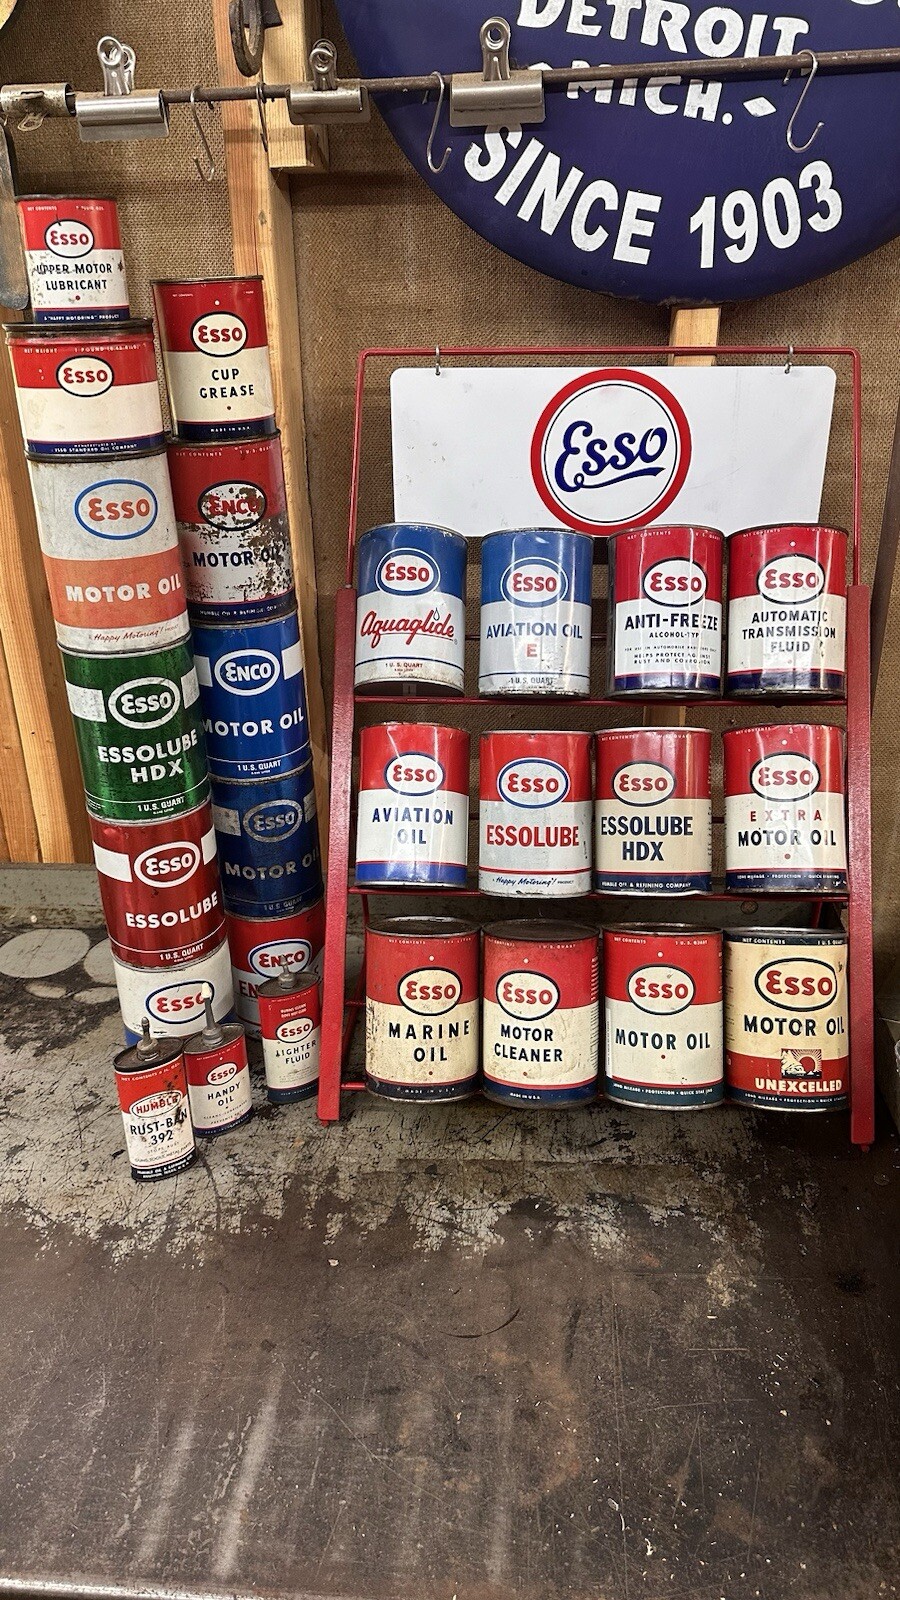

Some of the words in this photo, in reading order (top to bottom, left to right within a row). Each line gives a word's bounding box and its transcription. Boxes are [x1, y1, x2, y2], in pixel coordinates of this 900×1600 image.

[516, 0, 810, 85] DETROIT
[566, 60, 733, 125] MICH.
[464, 125, 662, 266] SINCE
[689, 160, 843, 269] 1903
[50, 230, 89, 246] Esso
[36, 263, 70, 275] UPPER
[75, 263, 112, 274] MOTOR
[46, 279, 107, 291] LUBRICANT
[198, 325, 243, 344] Esso
[63, 367, 108, 384] Esso
[211, 368, 240, 381] CUP
[199, 384, 255, 399] GREASE
[554, 420, 668, 493] Esso
[88, 497, 151, 522] Esso
[208, 495, 261, 516] ENCO
[192, 550, 255, 569] MOTOR
[384, 562, 430, 582] Esso
[764, 568, 820, 589] Esso
[65, 583, 152, 603] MOTOR
[157, 573, 182, 596] OIL
[512, 572, 557, 593] Esso
[649, 572, 702, 592] Esso
[624, 613, 718, 632] ANTI-FREEZE
[751, 610, 828, 624] AUTOMATIC
[360, 609, 454, 649] Aquaglide
[486, 622, 557, 640] AVIATION
[562, 623, 583, 639] OIL
[649, 631, 700, 639] ALCOHOL-YP
[742, 626, 836, 640] TRANSMISSION
[526, 643, 537, 657] E
[770, 641, 811, 653] FLUID
[225, 661, 272, 682] ENCO
[121, 691, 172, 715] Esso
[202, 718, 274, 737] MOTOR
[279, 706, 305, 730] OIL
[97, 728, 198, 764] ESSOLUBE
[130, 758, 184, 783] HDX
[258, 760, 281, 771] QUART
[392, 764, 438, 783] Esso
[507, 773, 559, 793] Esso
[619, 774, 668, 792] Esso
[758, 766, 814, 787] Esso
[161, 796, 185, 809] QUART
[253, 811, 295, 831] Esso
[372, 807, 453, 825] AVIATION
[750, 810, 822, 822] EXTRA
[486, 824, 579, 847] ESSOLUBE
[601, 816, 693, 836] ESSOLUBE
[397, 829, 427, 845] OIL
[738, 829, 801, 847] MOTOR
[810, 829, 836, 846] OIL
[622, 841, 664, 861] HDX
[145, 853, 193, 876] Esso
[225, 861, 297, 880] MOTOR
[125, 890, 218, 929] ESSOLUBE
[182, 943, 204, 957] QUART
[405, 980, 456, 1001] Esso
[634, 977, 689, 999] Esso
[766, 970, 833, 996] Esso
[502, 982, 553, 1005] Esso
[280, 1023, 311, 1037] Esso
[388, 1020, 470, 1040] MARINE
[500, 1024, 554, 1042] MOTOR
[744, 1014, 817, 1036] MOTOR
[825, 1017, 845, 1036] OIL
[275, 1040, 317, 1057] LIGHTER
[615, 1028, 677, 1050] MOTOR
[686, 1032, 710, 1050] OIL
[285, 1052, 311, 1065] FLUID
[413, 1046, 448, 1062] OIL
[494, 1043, 563, 1062] CLEANER
[210, 1067, 235, 1082] Esso
[207, 1081, 241, 1100] HANDY
[755, 1077, 842, 1094] UNEXCELLED
[136, 1093, 180, 1115] HUMBLE
[217, 1096, 235, 1107] OIL
[130, 1108, 188, 1136] RUST-BAN
[150, 1129, 174, 1146] 392
